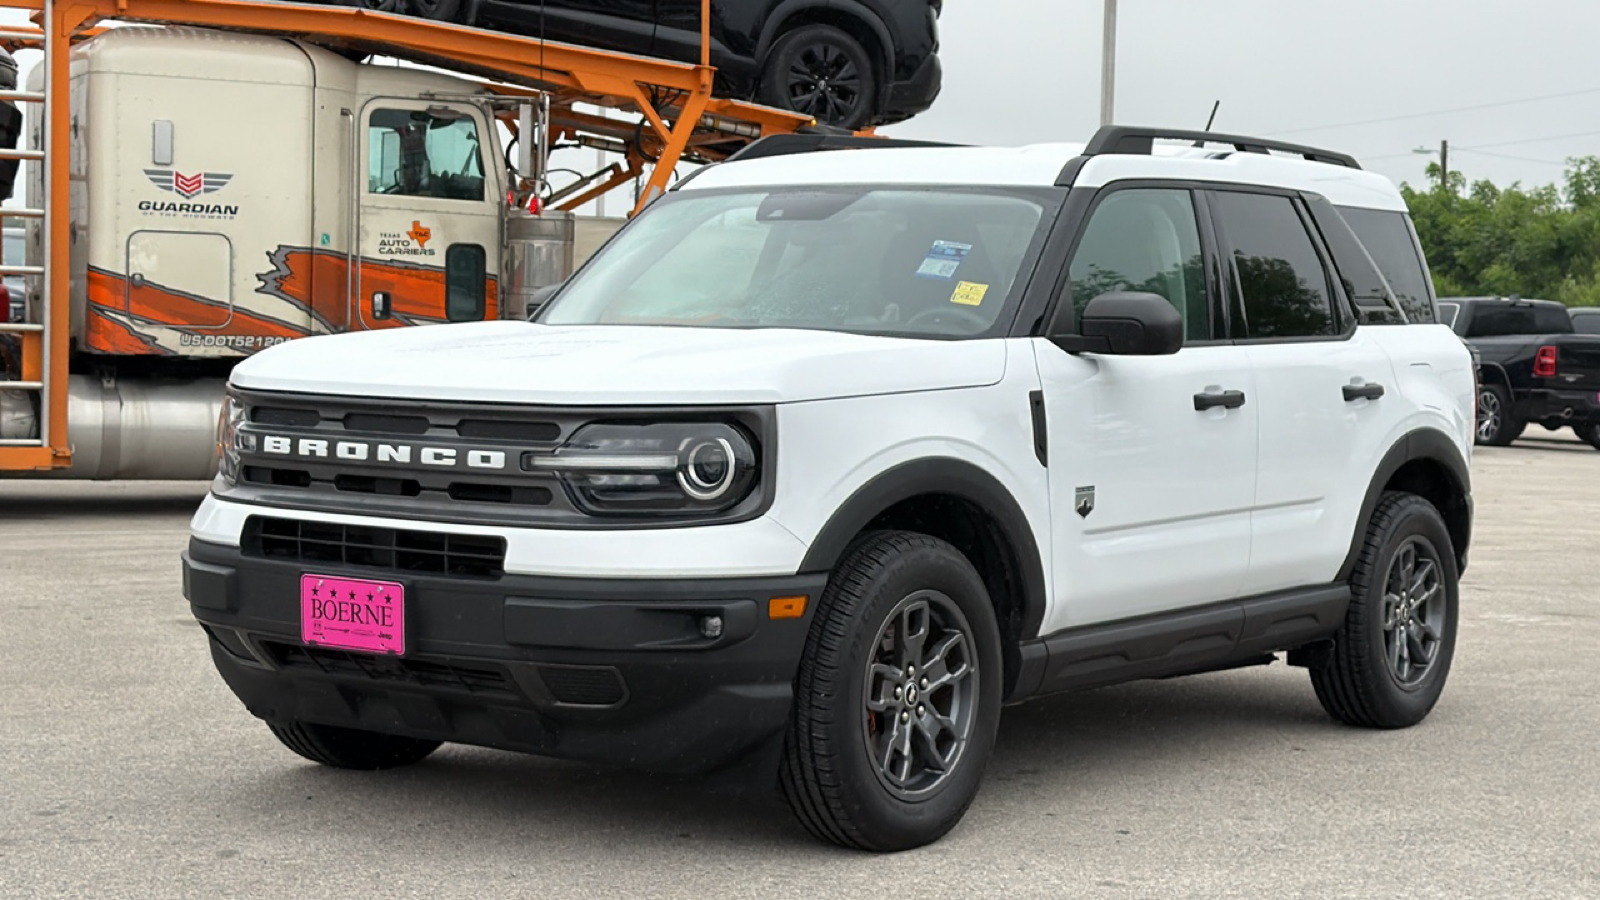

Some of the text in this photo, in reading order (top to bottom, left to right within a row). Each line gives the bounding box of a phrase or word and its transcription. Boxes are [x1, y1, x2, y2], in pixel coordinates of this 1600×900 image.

[138, 200, 239, 215] GUARDIAN
[379, 239, 411, 247] AUTO
[378, 247, 436, 256] CARRIERS
[181, 333, 201, 347] US
[263, 435, 507, 469] BRONCO
[311, 598, 395, 628] BOERNE
